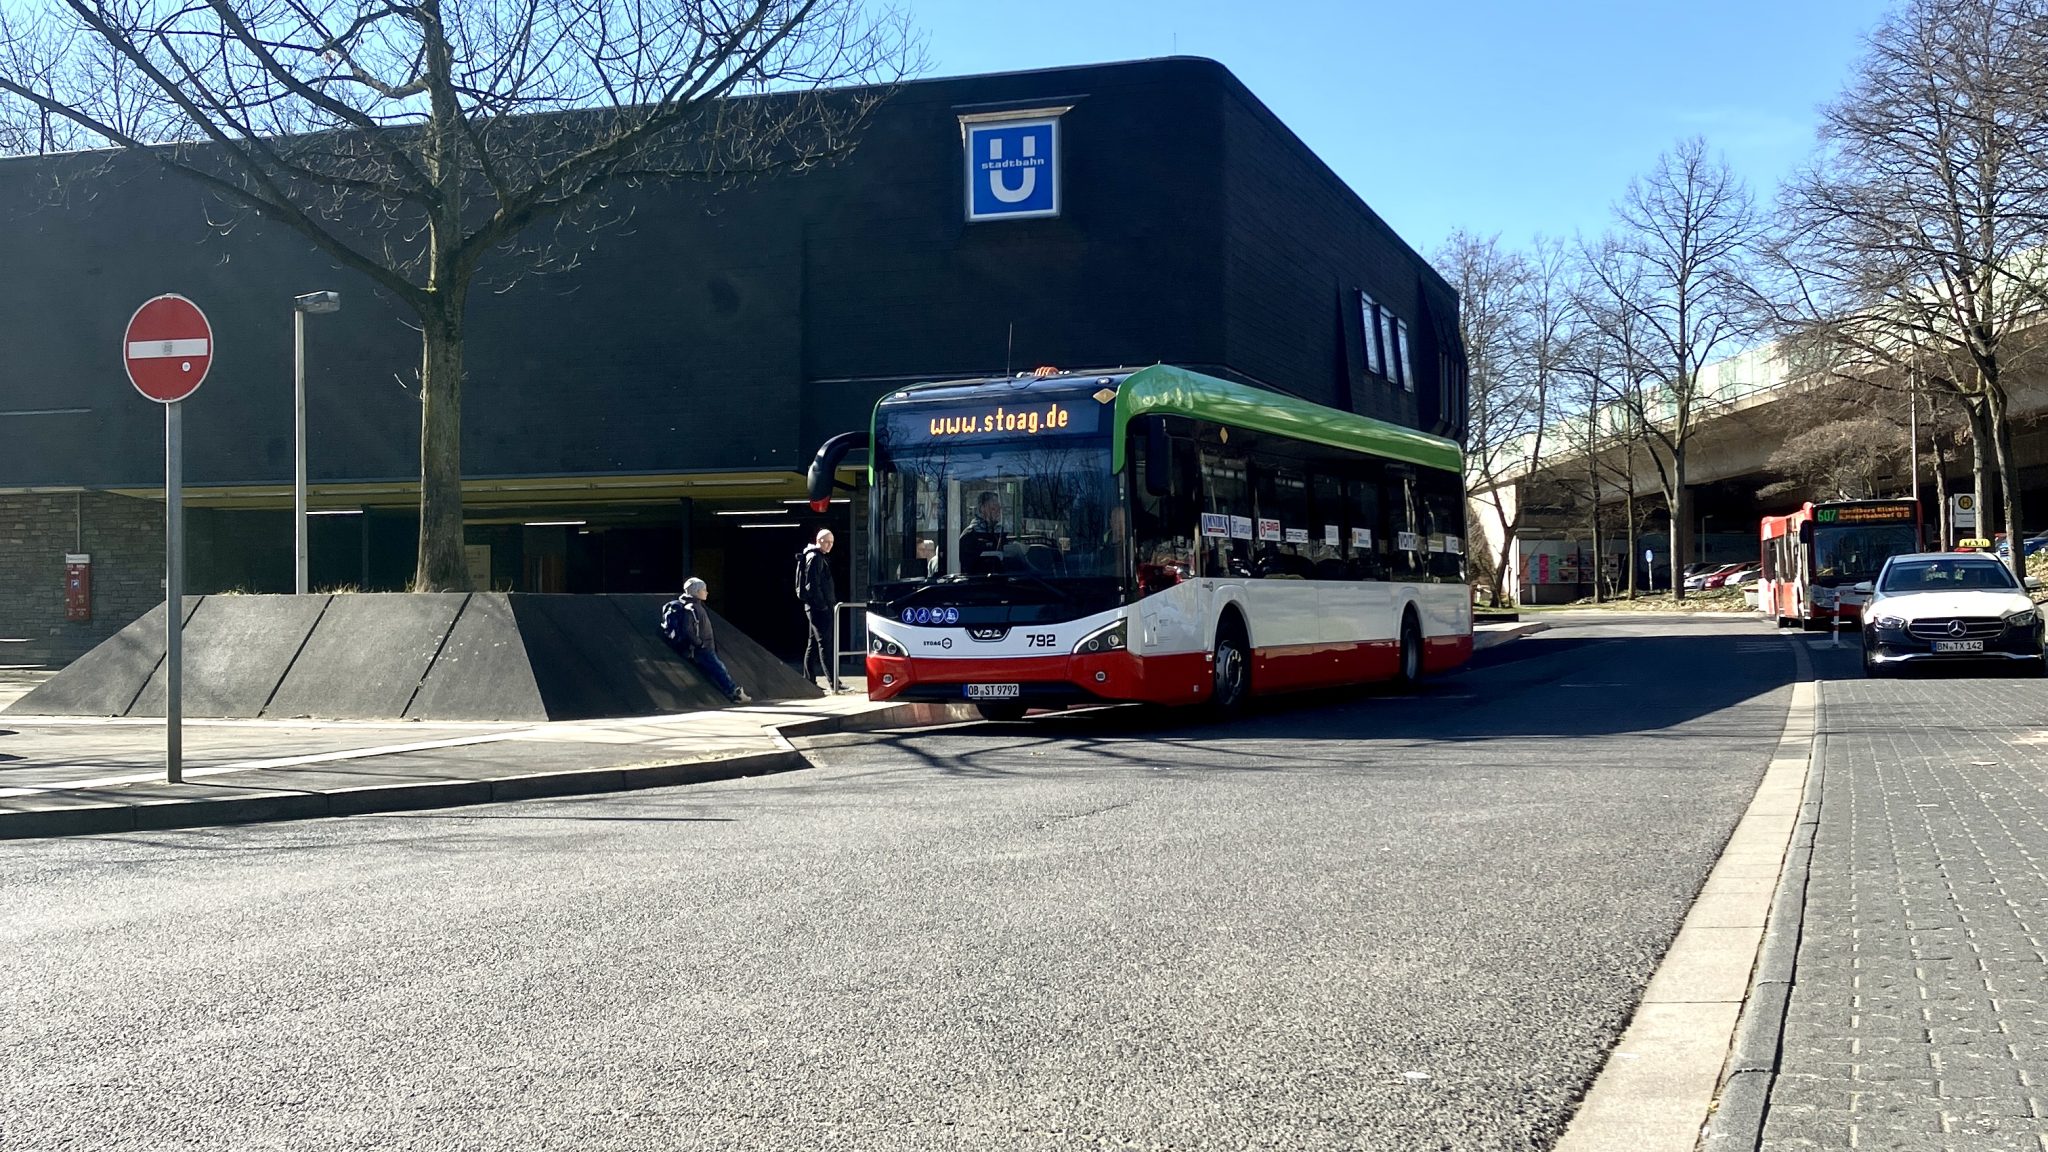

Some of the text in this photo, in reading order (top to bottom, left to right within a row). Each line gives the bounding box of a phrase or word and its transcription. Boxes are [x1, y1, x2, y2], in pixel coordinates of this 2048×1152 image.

[981, 158, 1045, 170] stadtbahn
[990, 136, 1035, 203] U
[930, 403, 1069, 434] www.stoag.de
[1817, 509, 1836, 522] 607
[1026, 634, 1057, 648] 792
[1937, 641, 1982, 651] BN TX 142
[968, 685, 1018, 696] OB ST 9792
